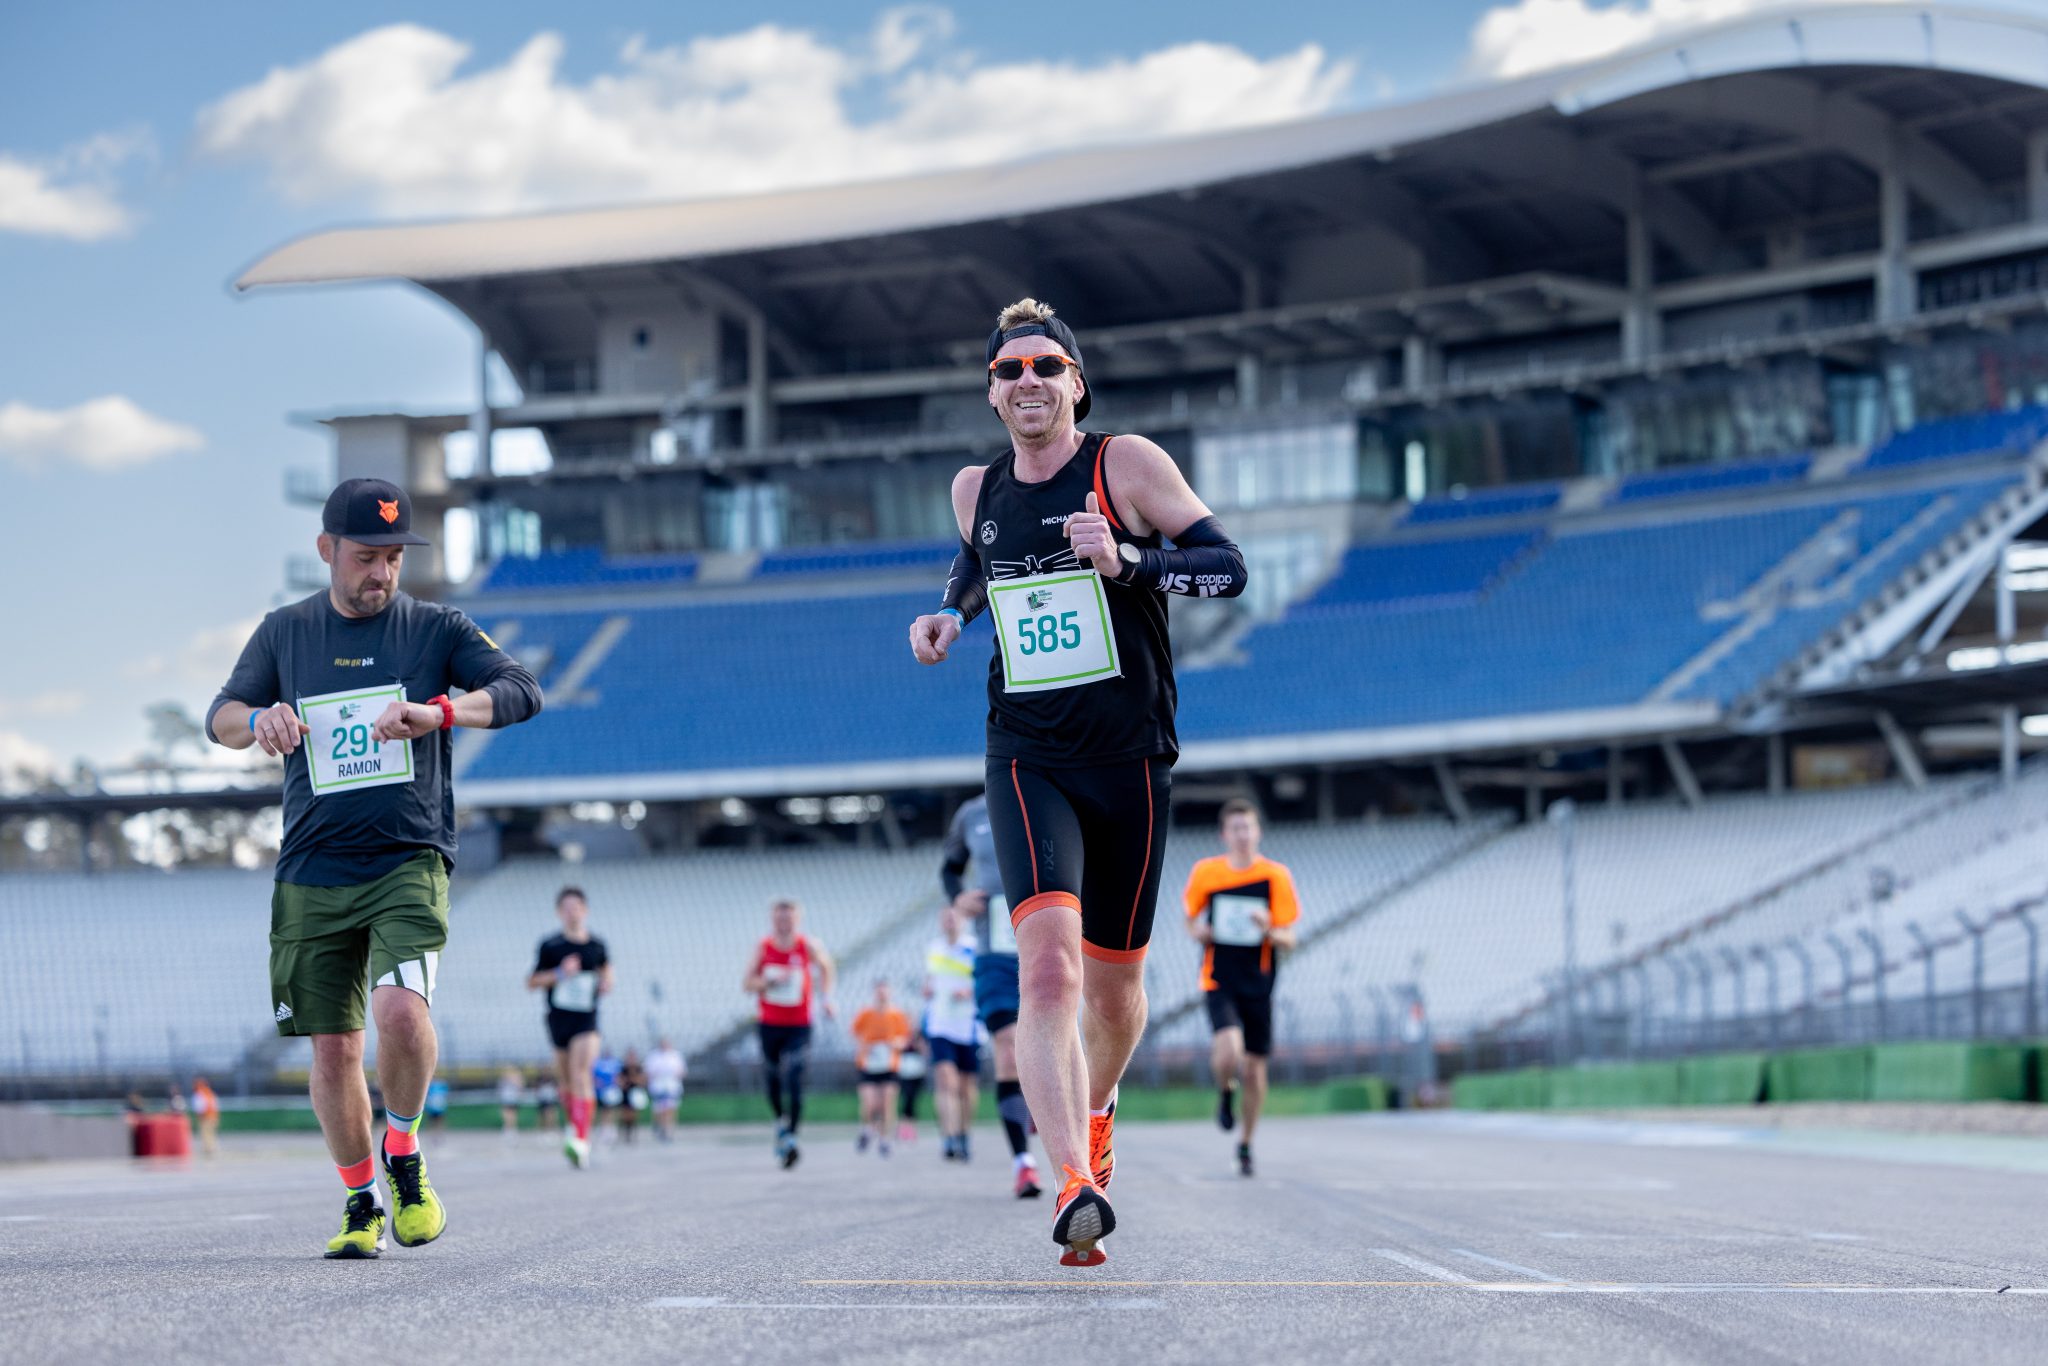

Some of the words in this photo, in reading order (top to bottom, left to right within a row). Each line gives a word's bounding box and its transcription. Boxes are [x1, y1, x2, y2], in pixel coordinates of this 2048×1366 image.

[1194, 574, 1233, 586] adidas
[1017, 610, 1081, 656] 585
[334, 657, 350, 667] RUN
[338, 759, 381, 778] RAMON
